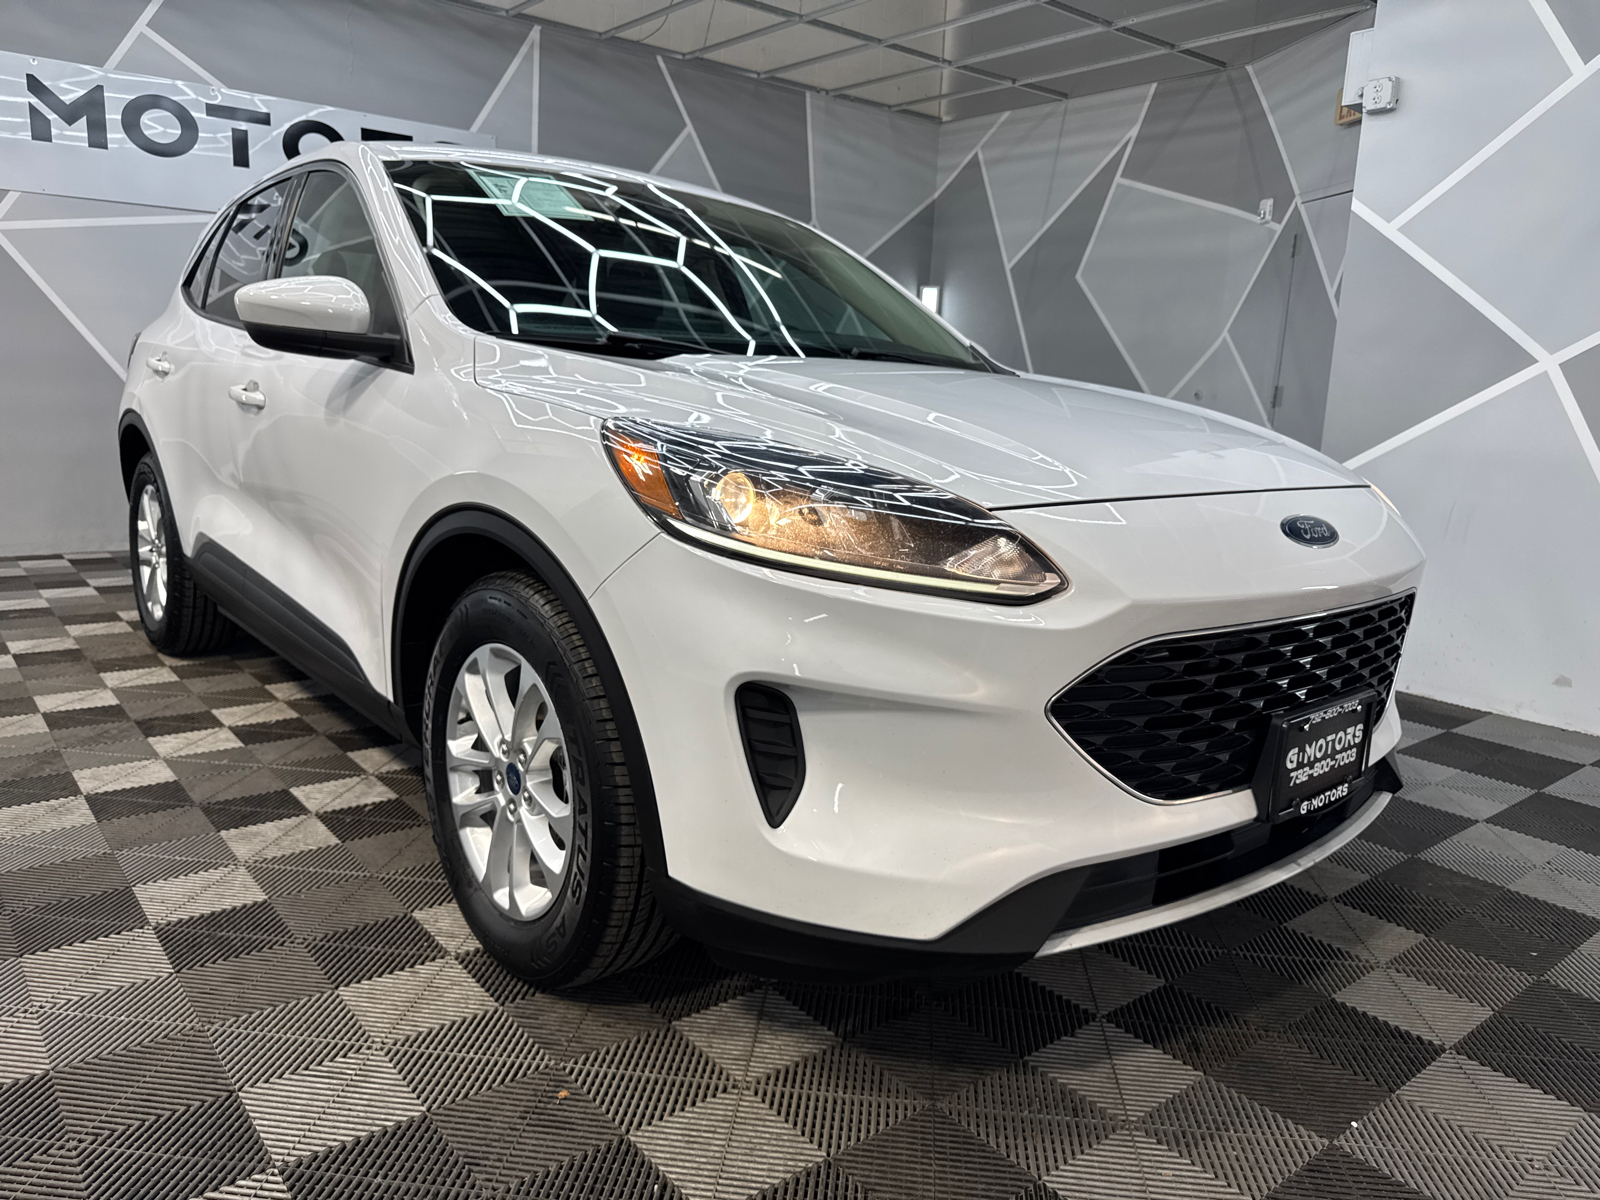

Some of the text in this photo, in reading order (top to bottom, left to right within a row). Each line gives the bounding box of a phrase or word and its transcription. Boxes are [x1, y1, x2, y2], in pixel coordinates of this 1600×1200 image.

[1297, 520, 1330, 539] Ford
[1289, 747, 1357, 786] 732-800-7003
[559, 703, 590, 906] TRATUS
